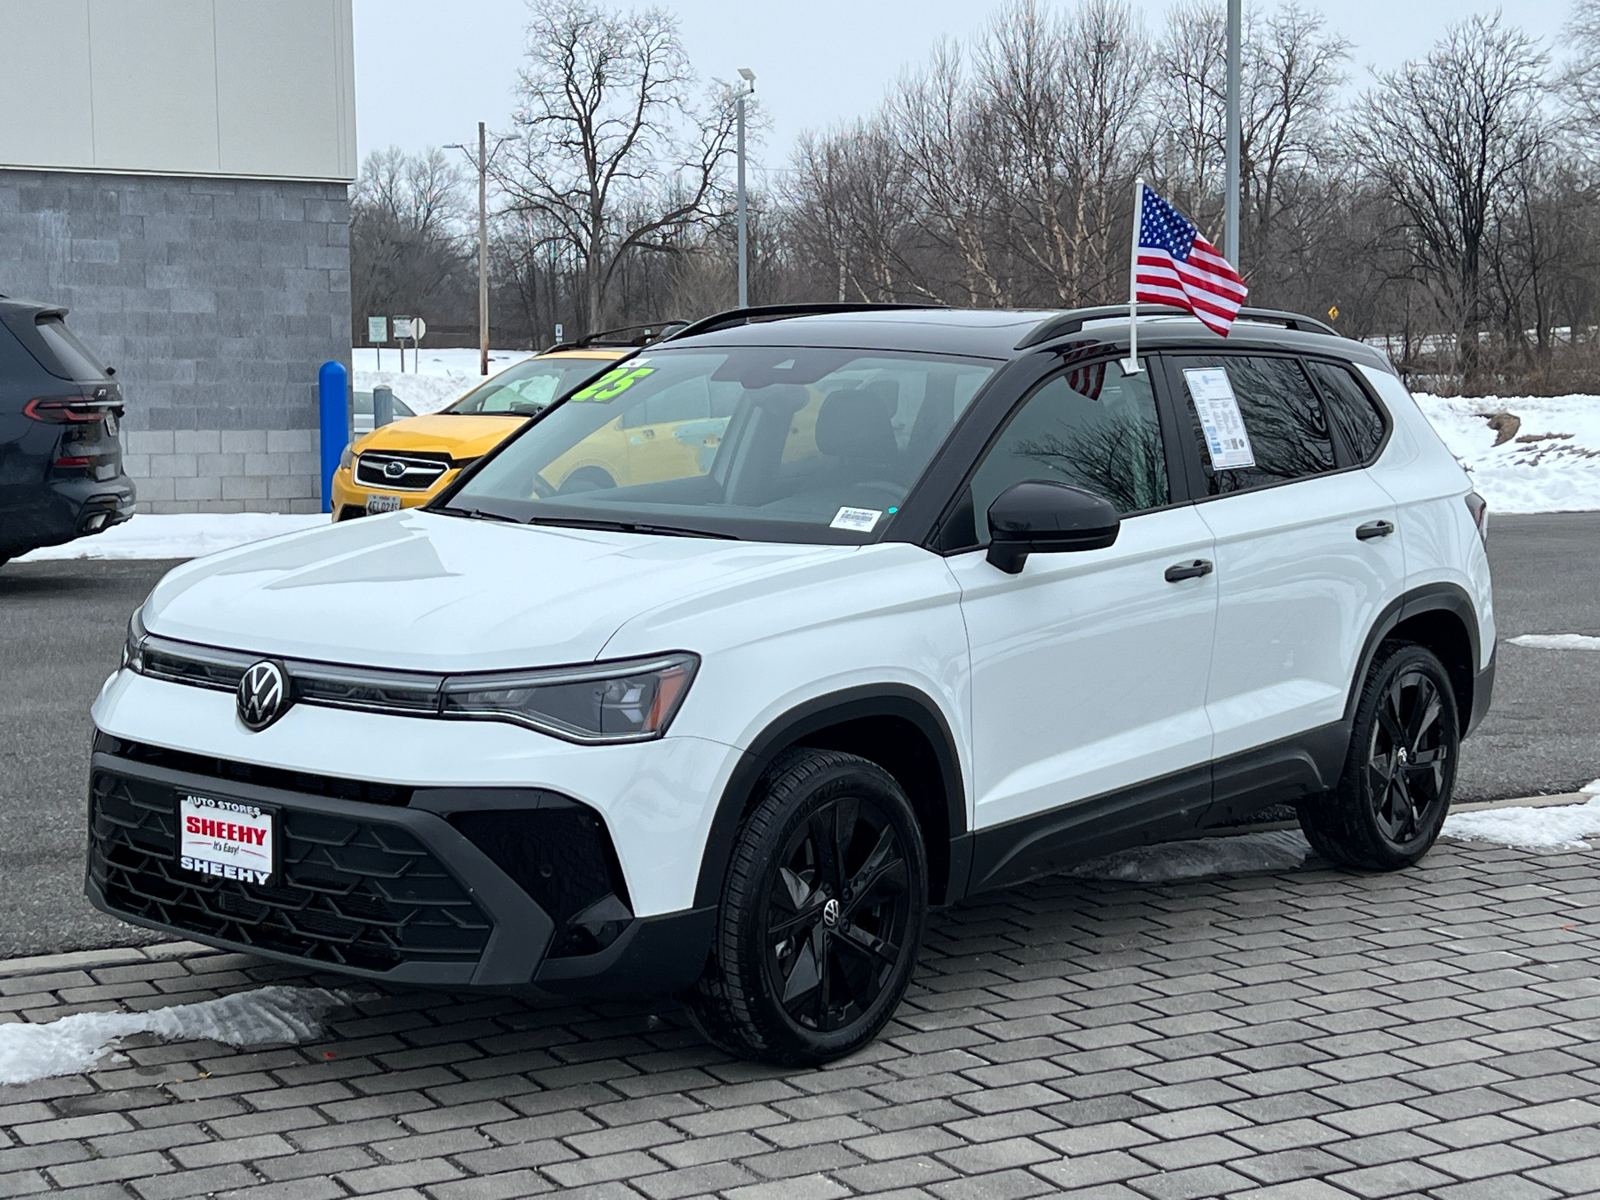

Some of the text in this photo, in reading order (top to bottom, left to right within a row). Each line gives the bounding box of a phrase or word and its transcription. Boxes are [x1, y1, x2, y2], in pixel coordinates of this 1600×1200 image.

[570, 367, 656, 402] 25
[186, 795, 261, 816] AUTO STORES
[186, 815, 268, 847] SHEEHY
[213, 840, 240, 856] It's Easy!
[180, 856, 271, 886] SHEEHY
